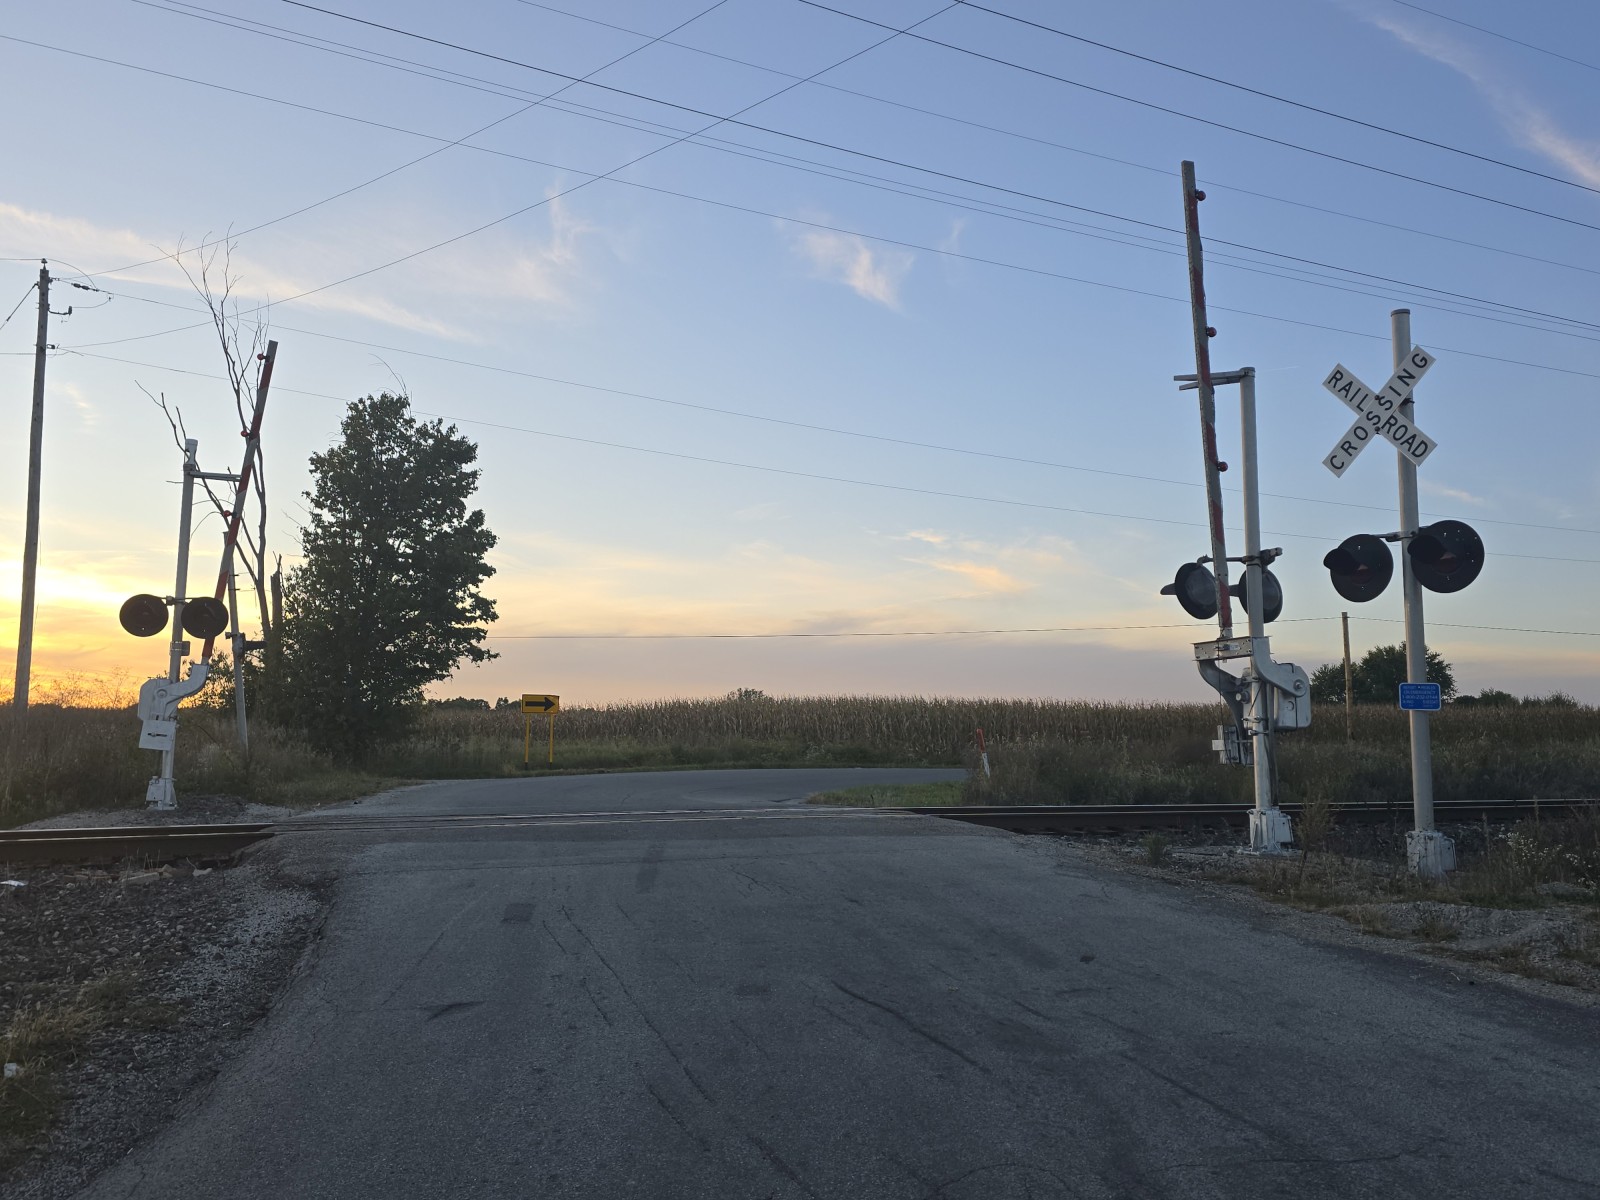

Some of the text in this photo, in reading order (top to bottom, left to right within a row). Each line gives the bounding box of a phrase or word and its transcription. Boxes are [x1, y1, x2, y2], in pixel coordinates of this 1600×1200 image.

[1327, 369, 1428, 458] RAIL ROAD
[1329, 352, 1428, 470] CROSSING
